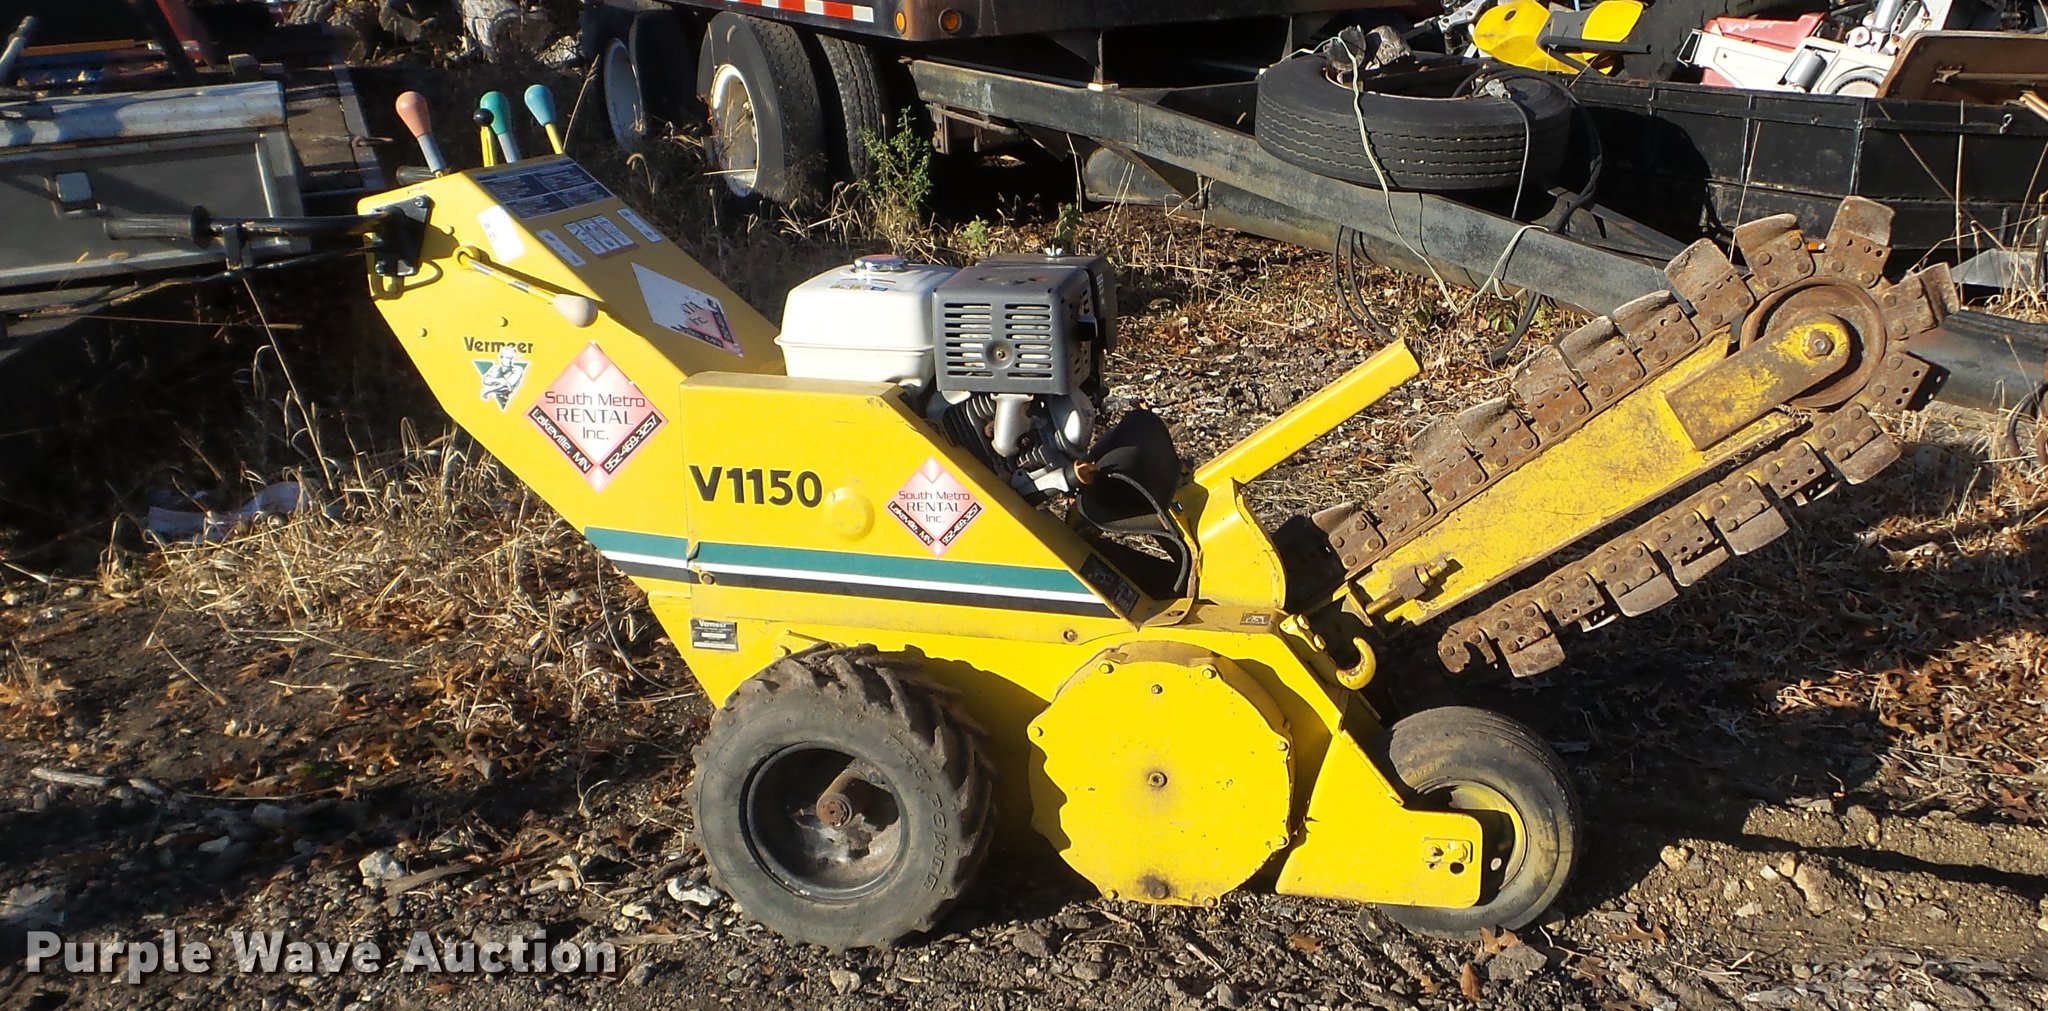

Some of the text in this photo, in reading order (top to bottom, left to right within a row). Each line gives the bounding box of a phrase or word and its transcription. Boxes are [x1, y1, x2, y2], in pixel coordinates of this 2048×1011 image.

[545, 391, 646, 408] South Metro
[556, 408, 635, 426] RENTAL
[530, 408, 592, 472] Lakeville, MN
[582, 426, 610, 440] Inc.
[604, 415, 659, 473] 952-469-3257
[688, 464, 824, 508] V1150
[898, 490, 971, 501] South Metro
[906, 501, 963, 512] RENTAL
[925, 513, 946, 523] Inc.
[918, 530, 933, 544] MN
[923, 791, 948, 891] POWER
